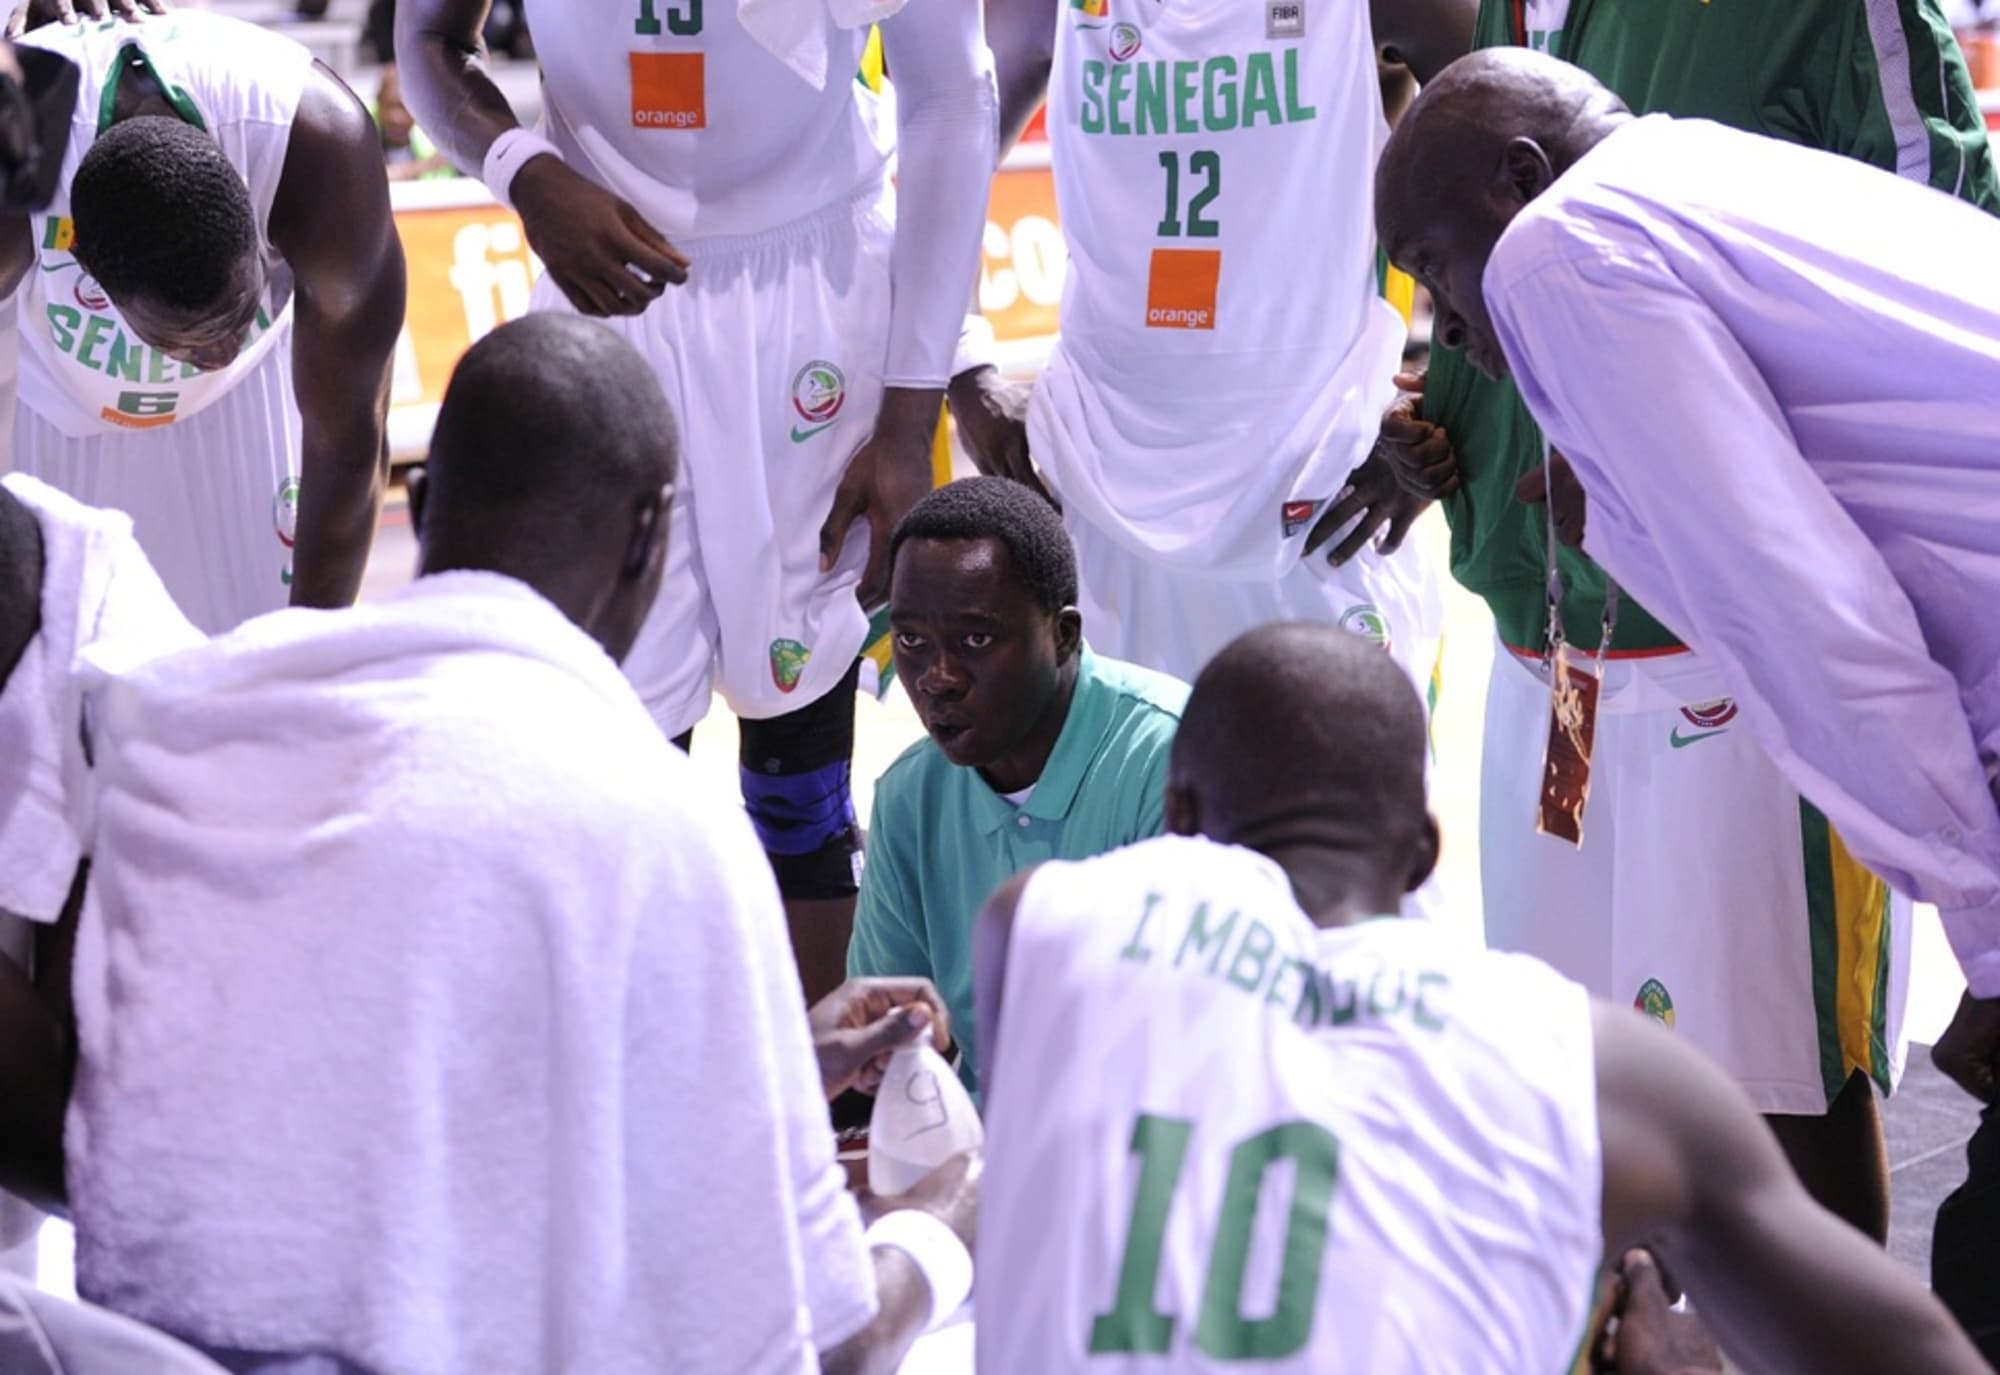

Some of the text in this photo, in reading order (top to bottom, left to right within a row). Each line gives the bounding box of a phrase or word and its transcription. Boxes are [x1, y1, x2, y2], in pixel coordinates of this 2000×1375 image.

[635, 110, 697, 127] orange
[1081, 48, 1316, 135] SENEGAL
[1157, 150, 1220, 237] 12
[47, 303, 270, 384] SENE
[1150, 308, 1208, 329] orange
[117, 391, 179, 415] 6
[1087, 1114, 1340, 1360] 10
